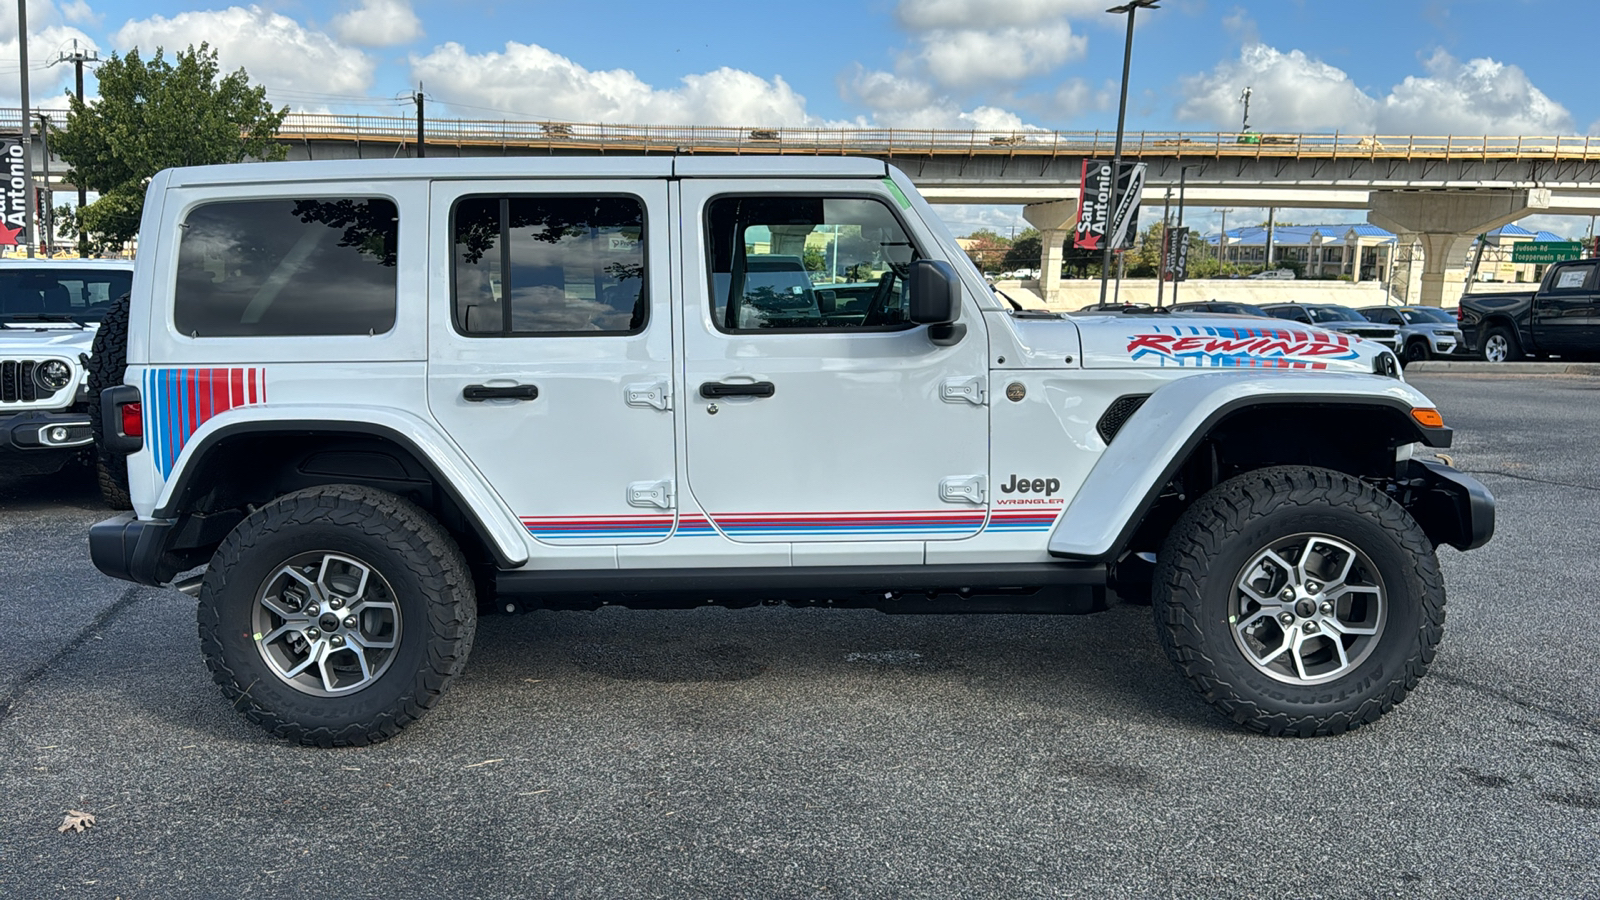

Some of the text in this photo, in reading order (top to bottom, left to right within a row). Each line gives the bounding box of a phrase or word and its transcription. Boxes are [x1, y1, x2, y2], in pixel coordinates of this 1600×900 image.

[5, 145, 26, 228] Antonio
[1092, 165, 1112, 235] Antonio
[1077, 200, 1094, 233] San
[1175, 233, 1188, 278] Jeep
[1514, 253, 1554, 261] Toepperwein
[1127, 334, 1349, 356] REWIND
[1001, 474, 1060, 496] Jeep
